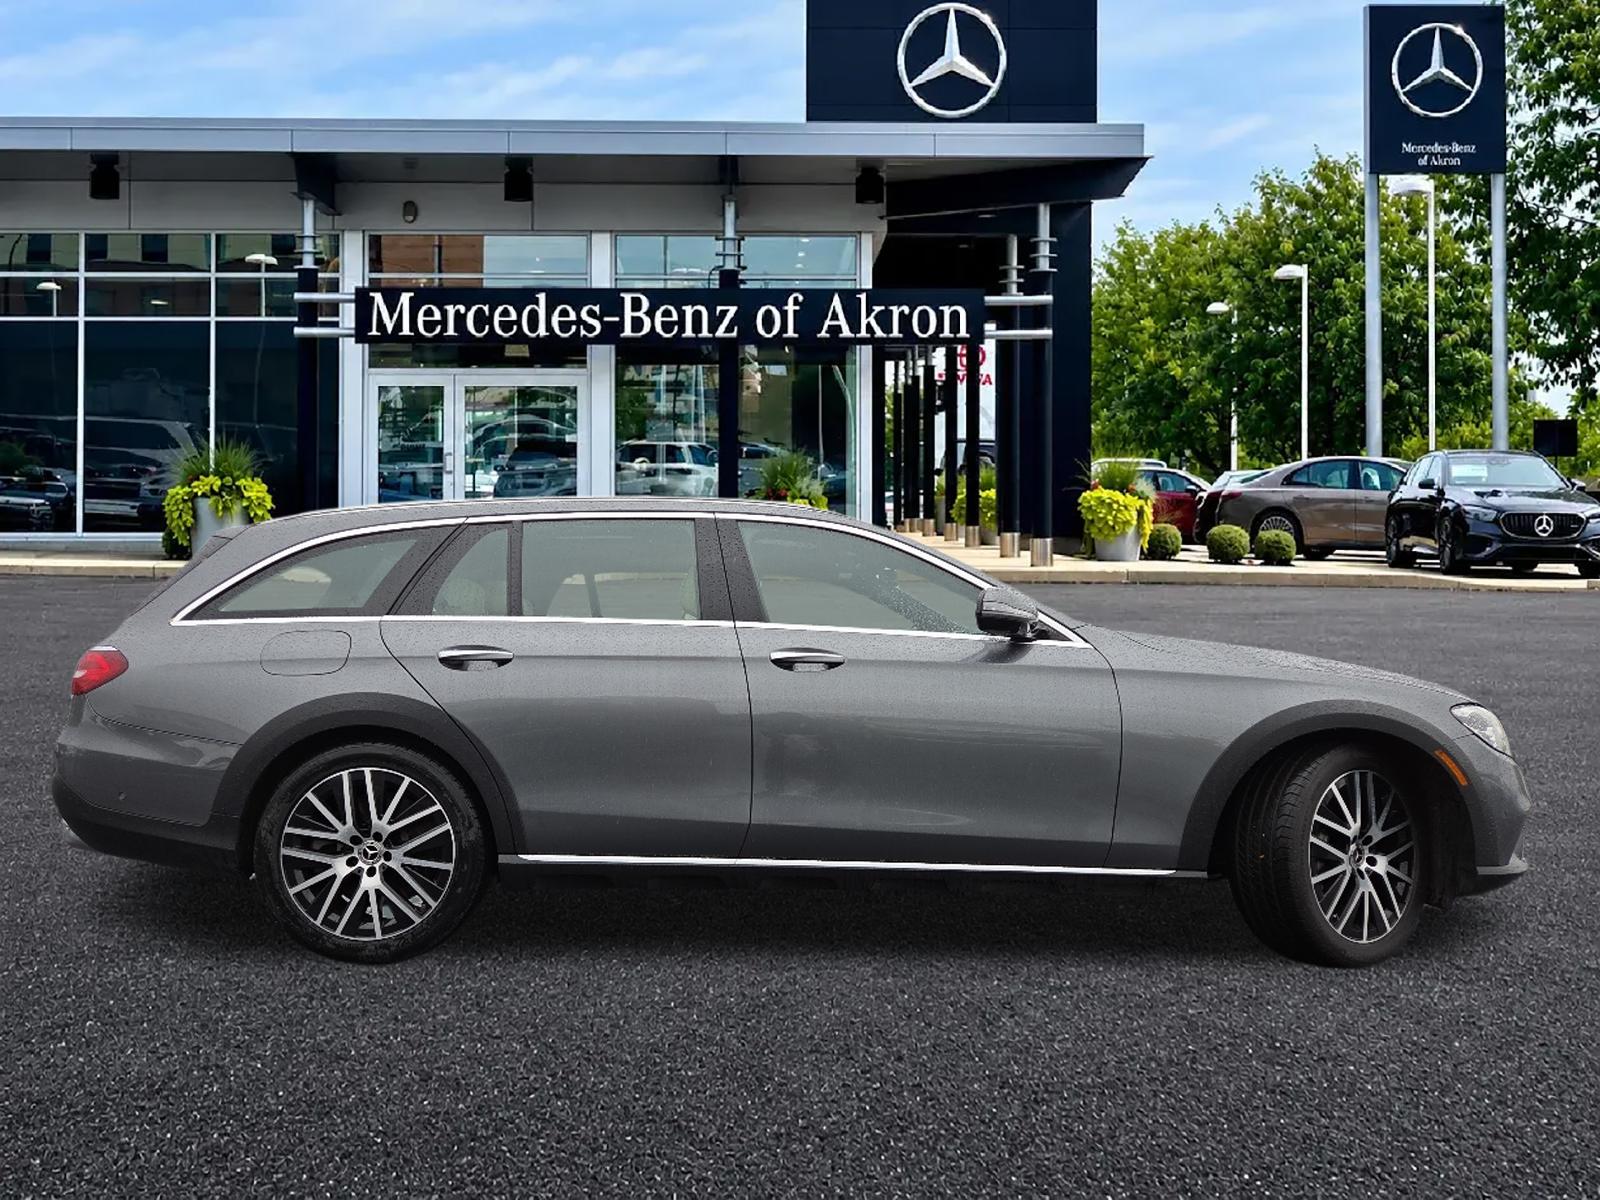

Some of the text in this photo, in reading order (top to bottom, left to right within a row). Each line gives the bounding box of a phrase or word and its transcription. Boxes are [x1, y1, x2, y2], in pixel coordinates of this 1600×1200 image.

[1401, 142, 1476, 154] Mercedes-Benz
[1418, 154, 1461, 166] of Akron
[367, 292, 970, 338] Mercedes-Benz of Akron
